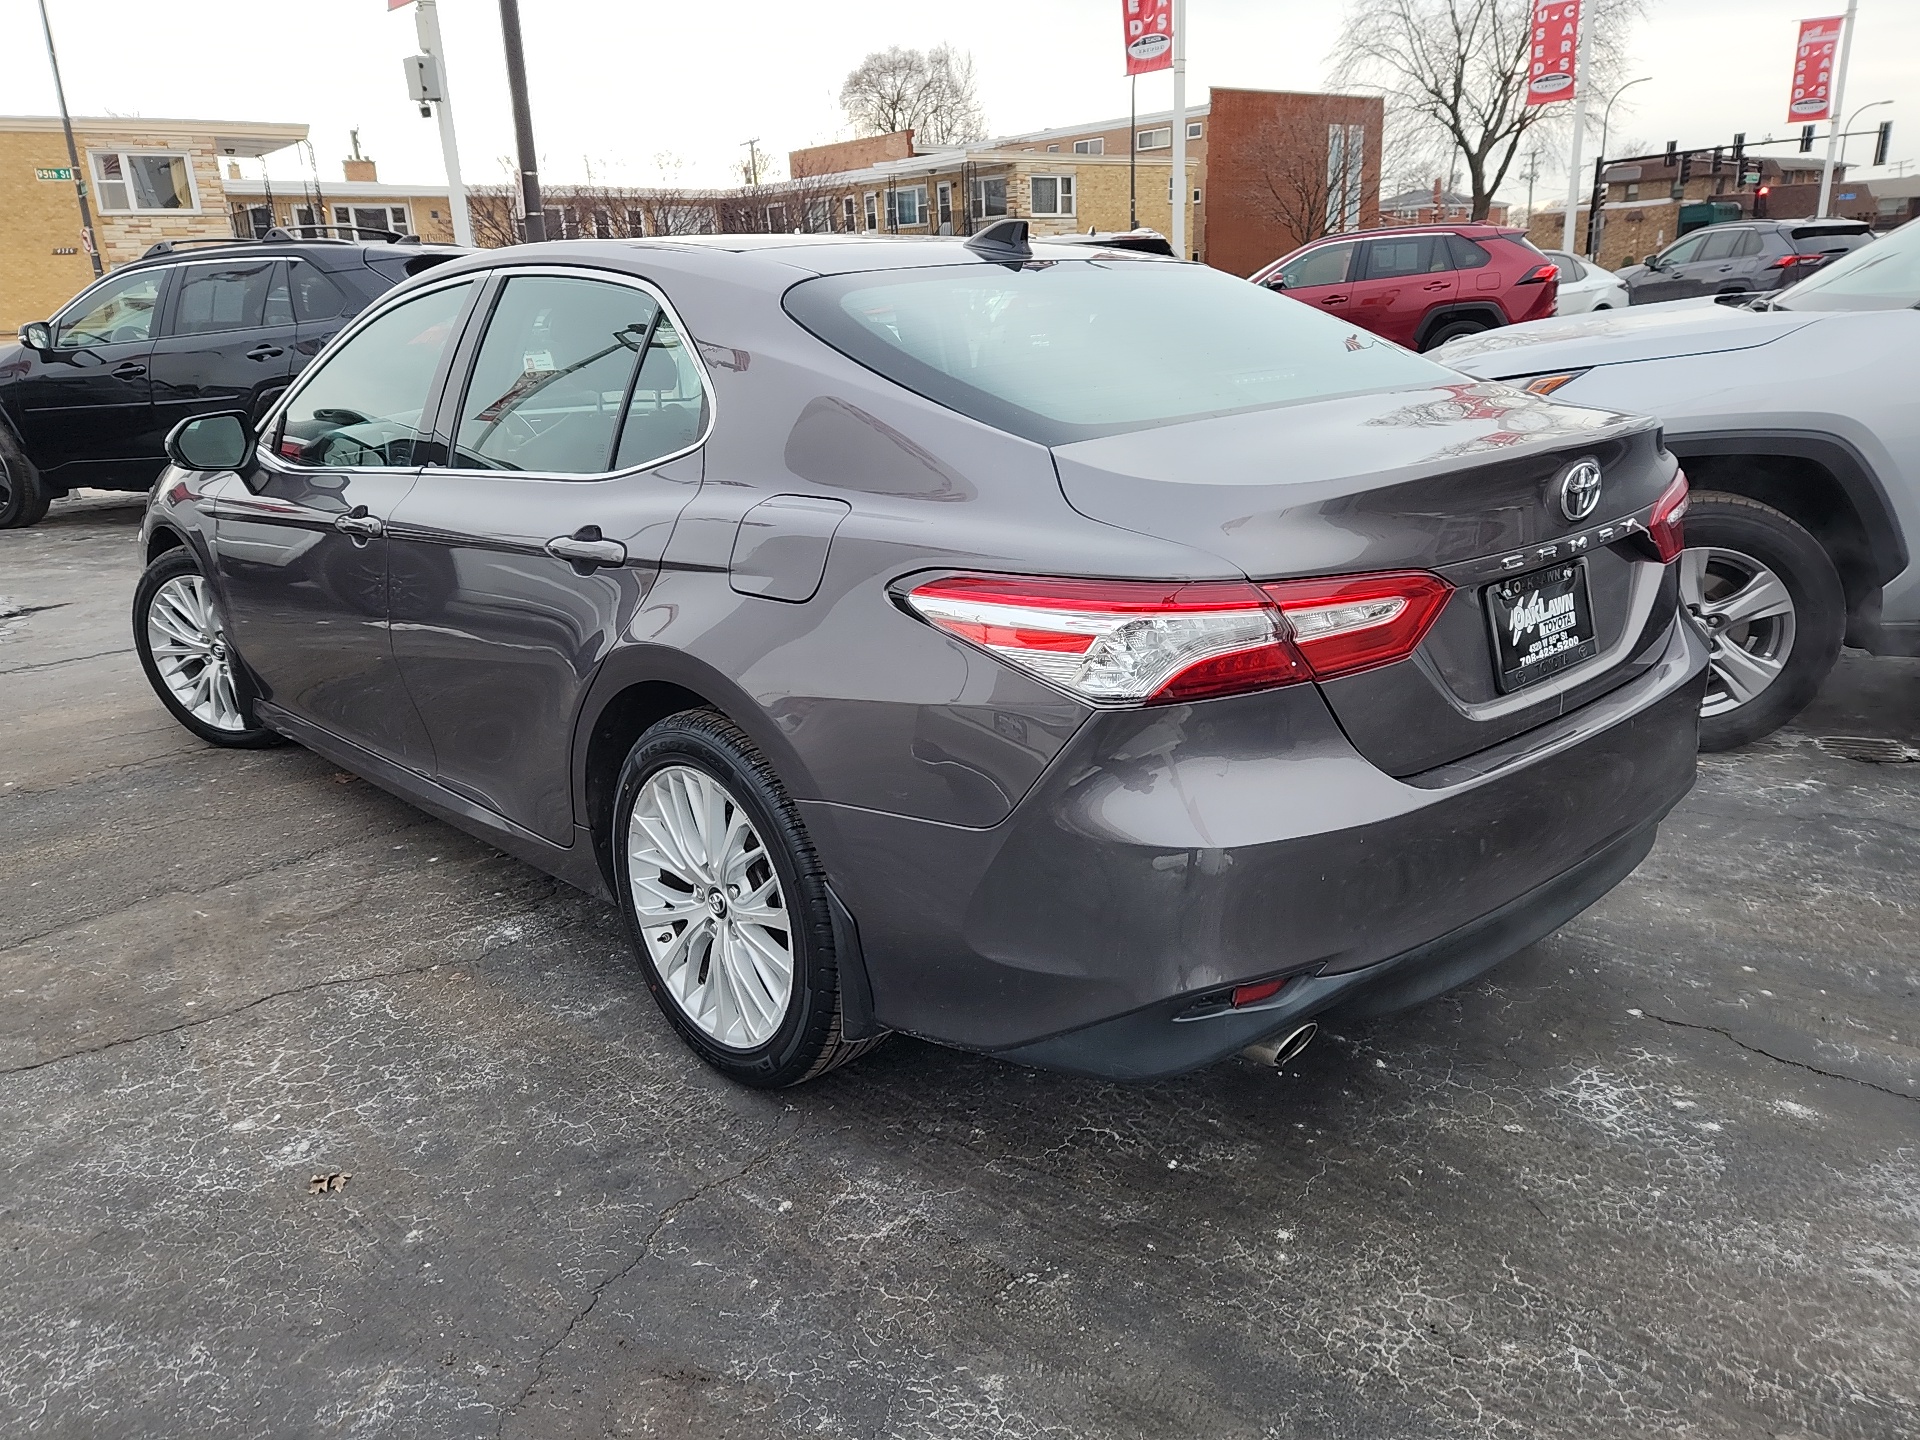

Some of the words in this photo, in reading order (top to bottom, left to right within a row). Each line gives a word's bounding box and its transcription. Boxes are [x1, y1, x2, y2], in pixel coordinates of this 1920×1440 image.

[1533, 9, 1548, 76] USED
[1559, 4, 1576, 71] CARS
[1794, 45, 1810, 99] USED
[1816, 43, 1833, 97] CARS
[36, 170, 58, 179] 95th
[60, 170, 70, 179] St
[1501, 518, 1638, 570] CAMRY
[1529, 640, 1543, 653] 4320
[1541, 637, 1548, 648] W
[1560, 630, 1569, 640] St
[1542, 614, 1573, 634] TOYOTA
[1519, 635, 1579, 668] 708-423-5200
